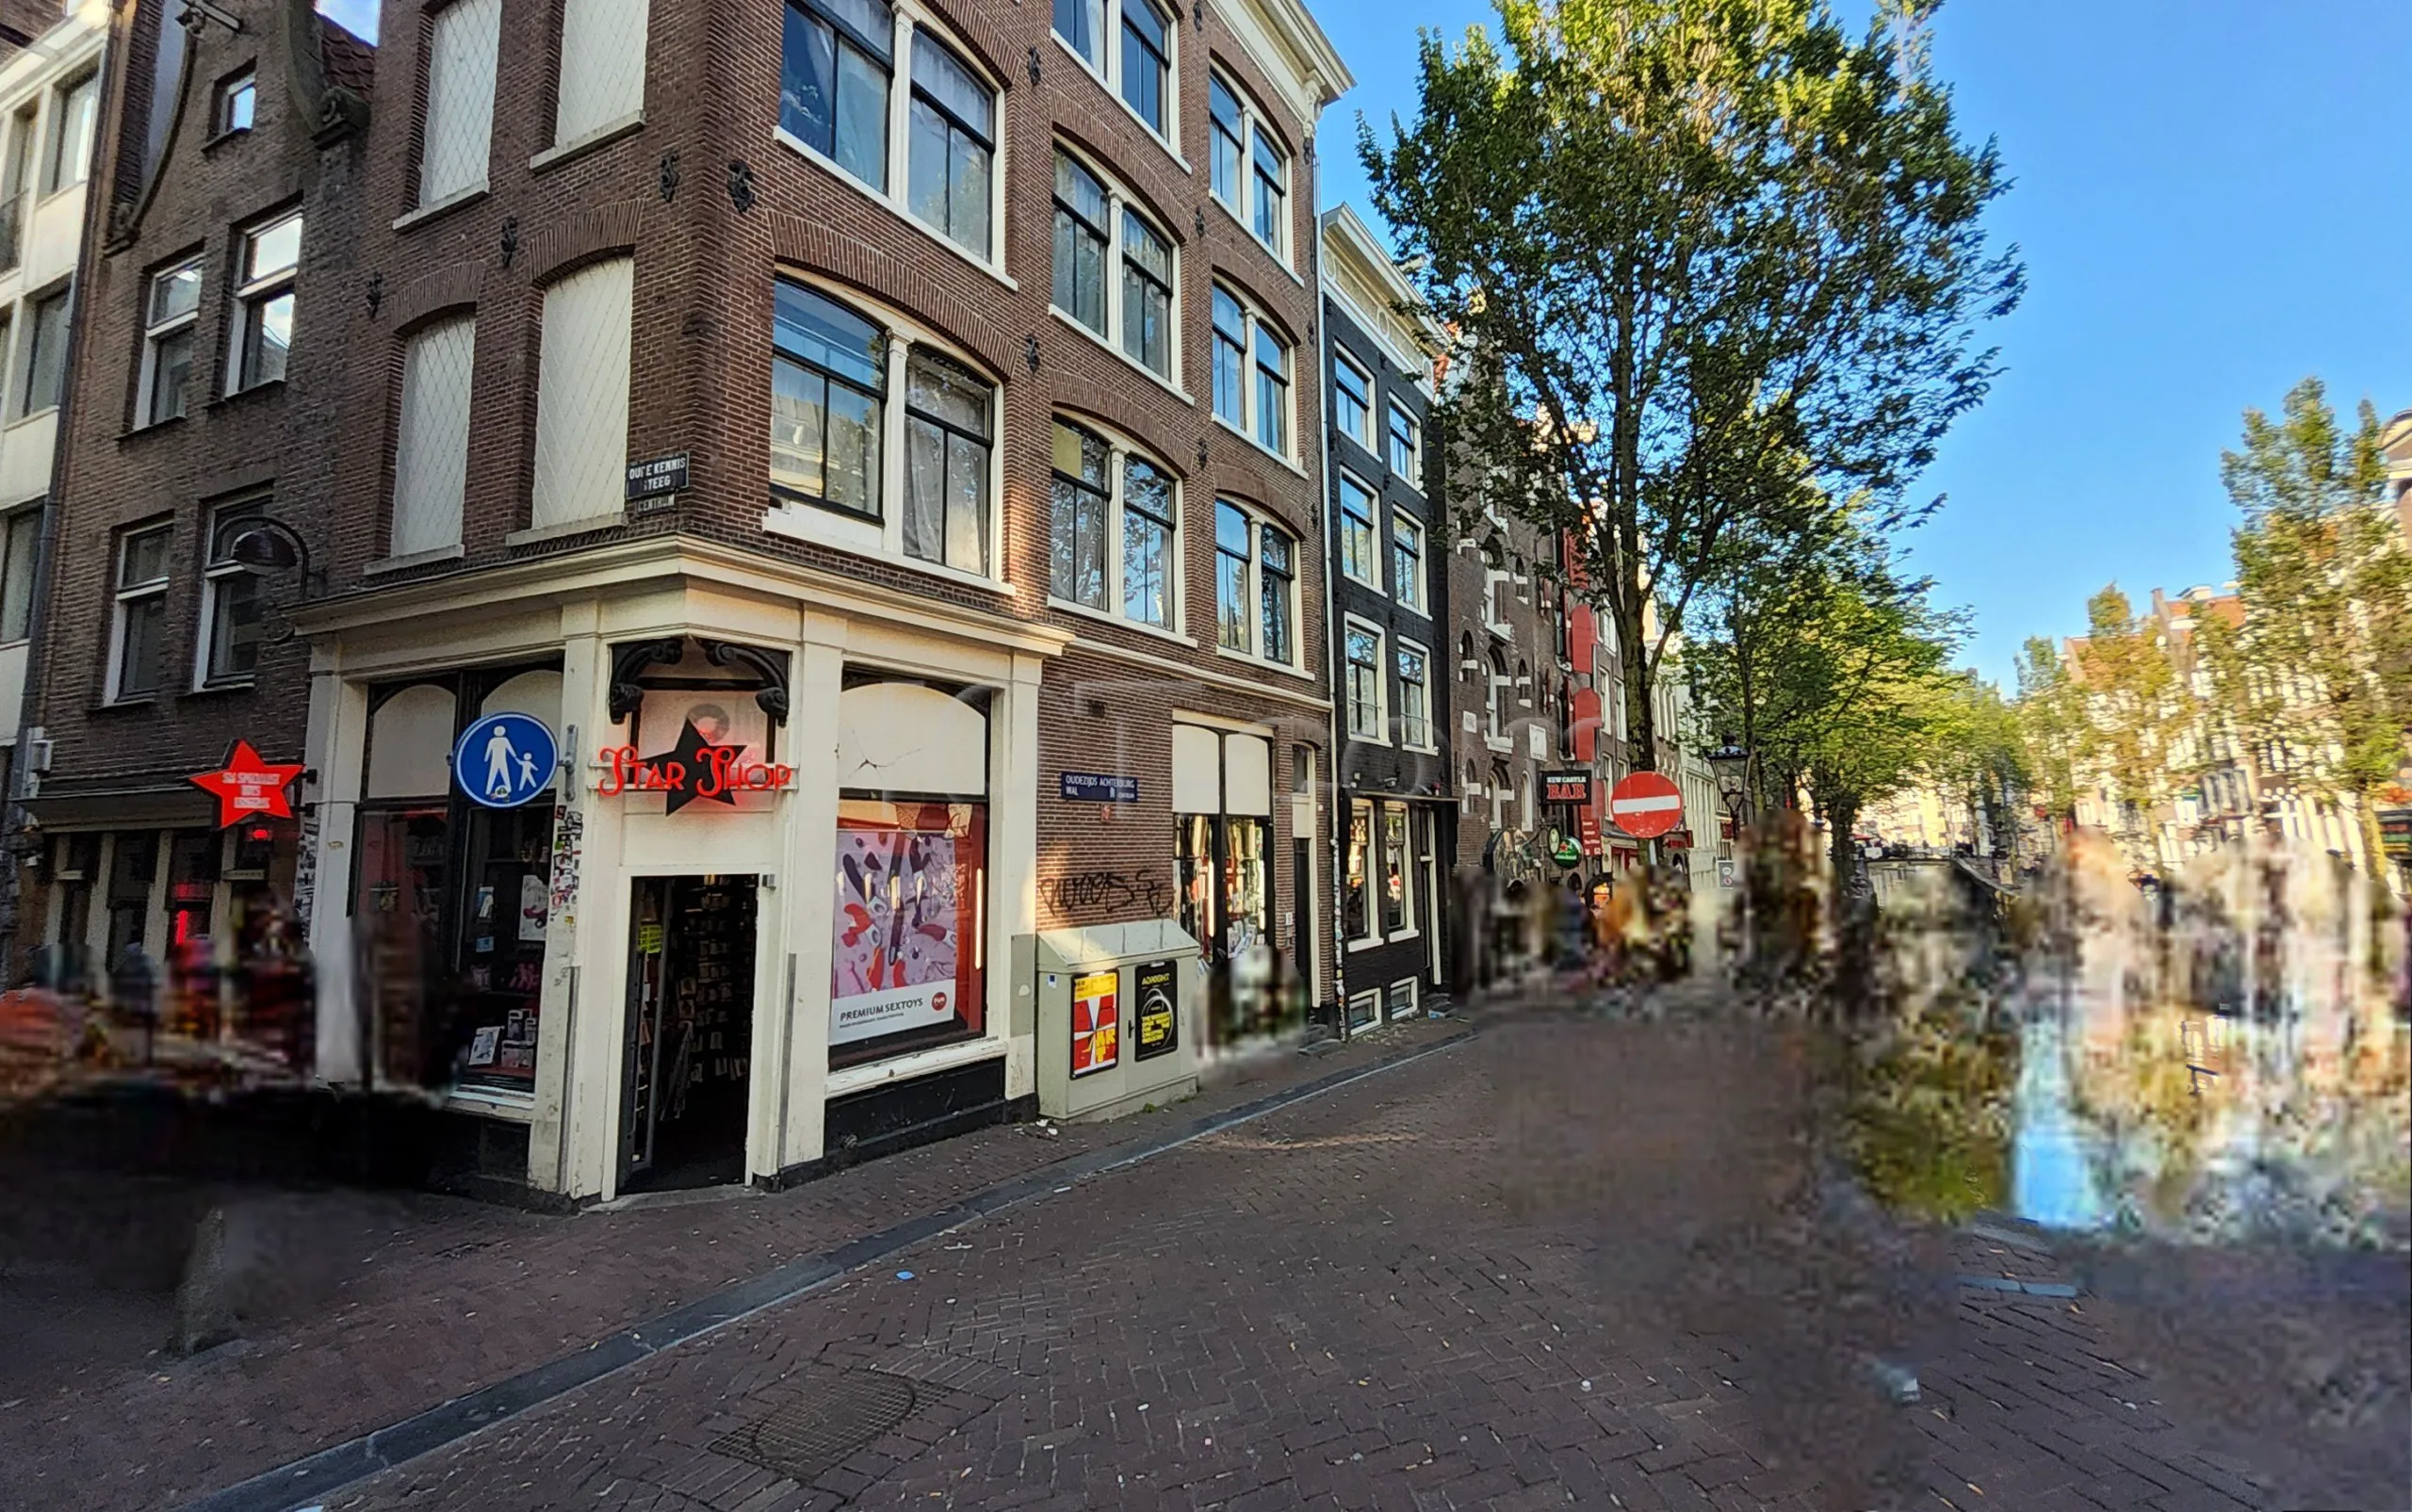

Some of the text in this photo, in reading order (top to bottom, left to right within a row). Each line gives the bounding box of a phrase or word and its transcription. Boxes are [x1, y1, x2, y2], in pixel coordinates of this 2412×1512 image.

[654, 458, 686, 474] KENNIS
[1066, 774, 1098, 788] OUDEZIJDS
[1066, 786, 1079, 796] WAL
[1546, 783, 1587, 800] BAR
[839, 1004, 885, 1021] PREMIUM
[885, 998, 923, 1013] SEXTOYS
